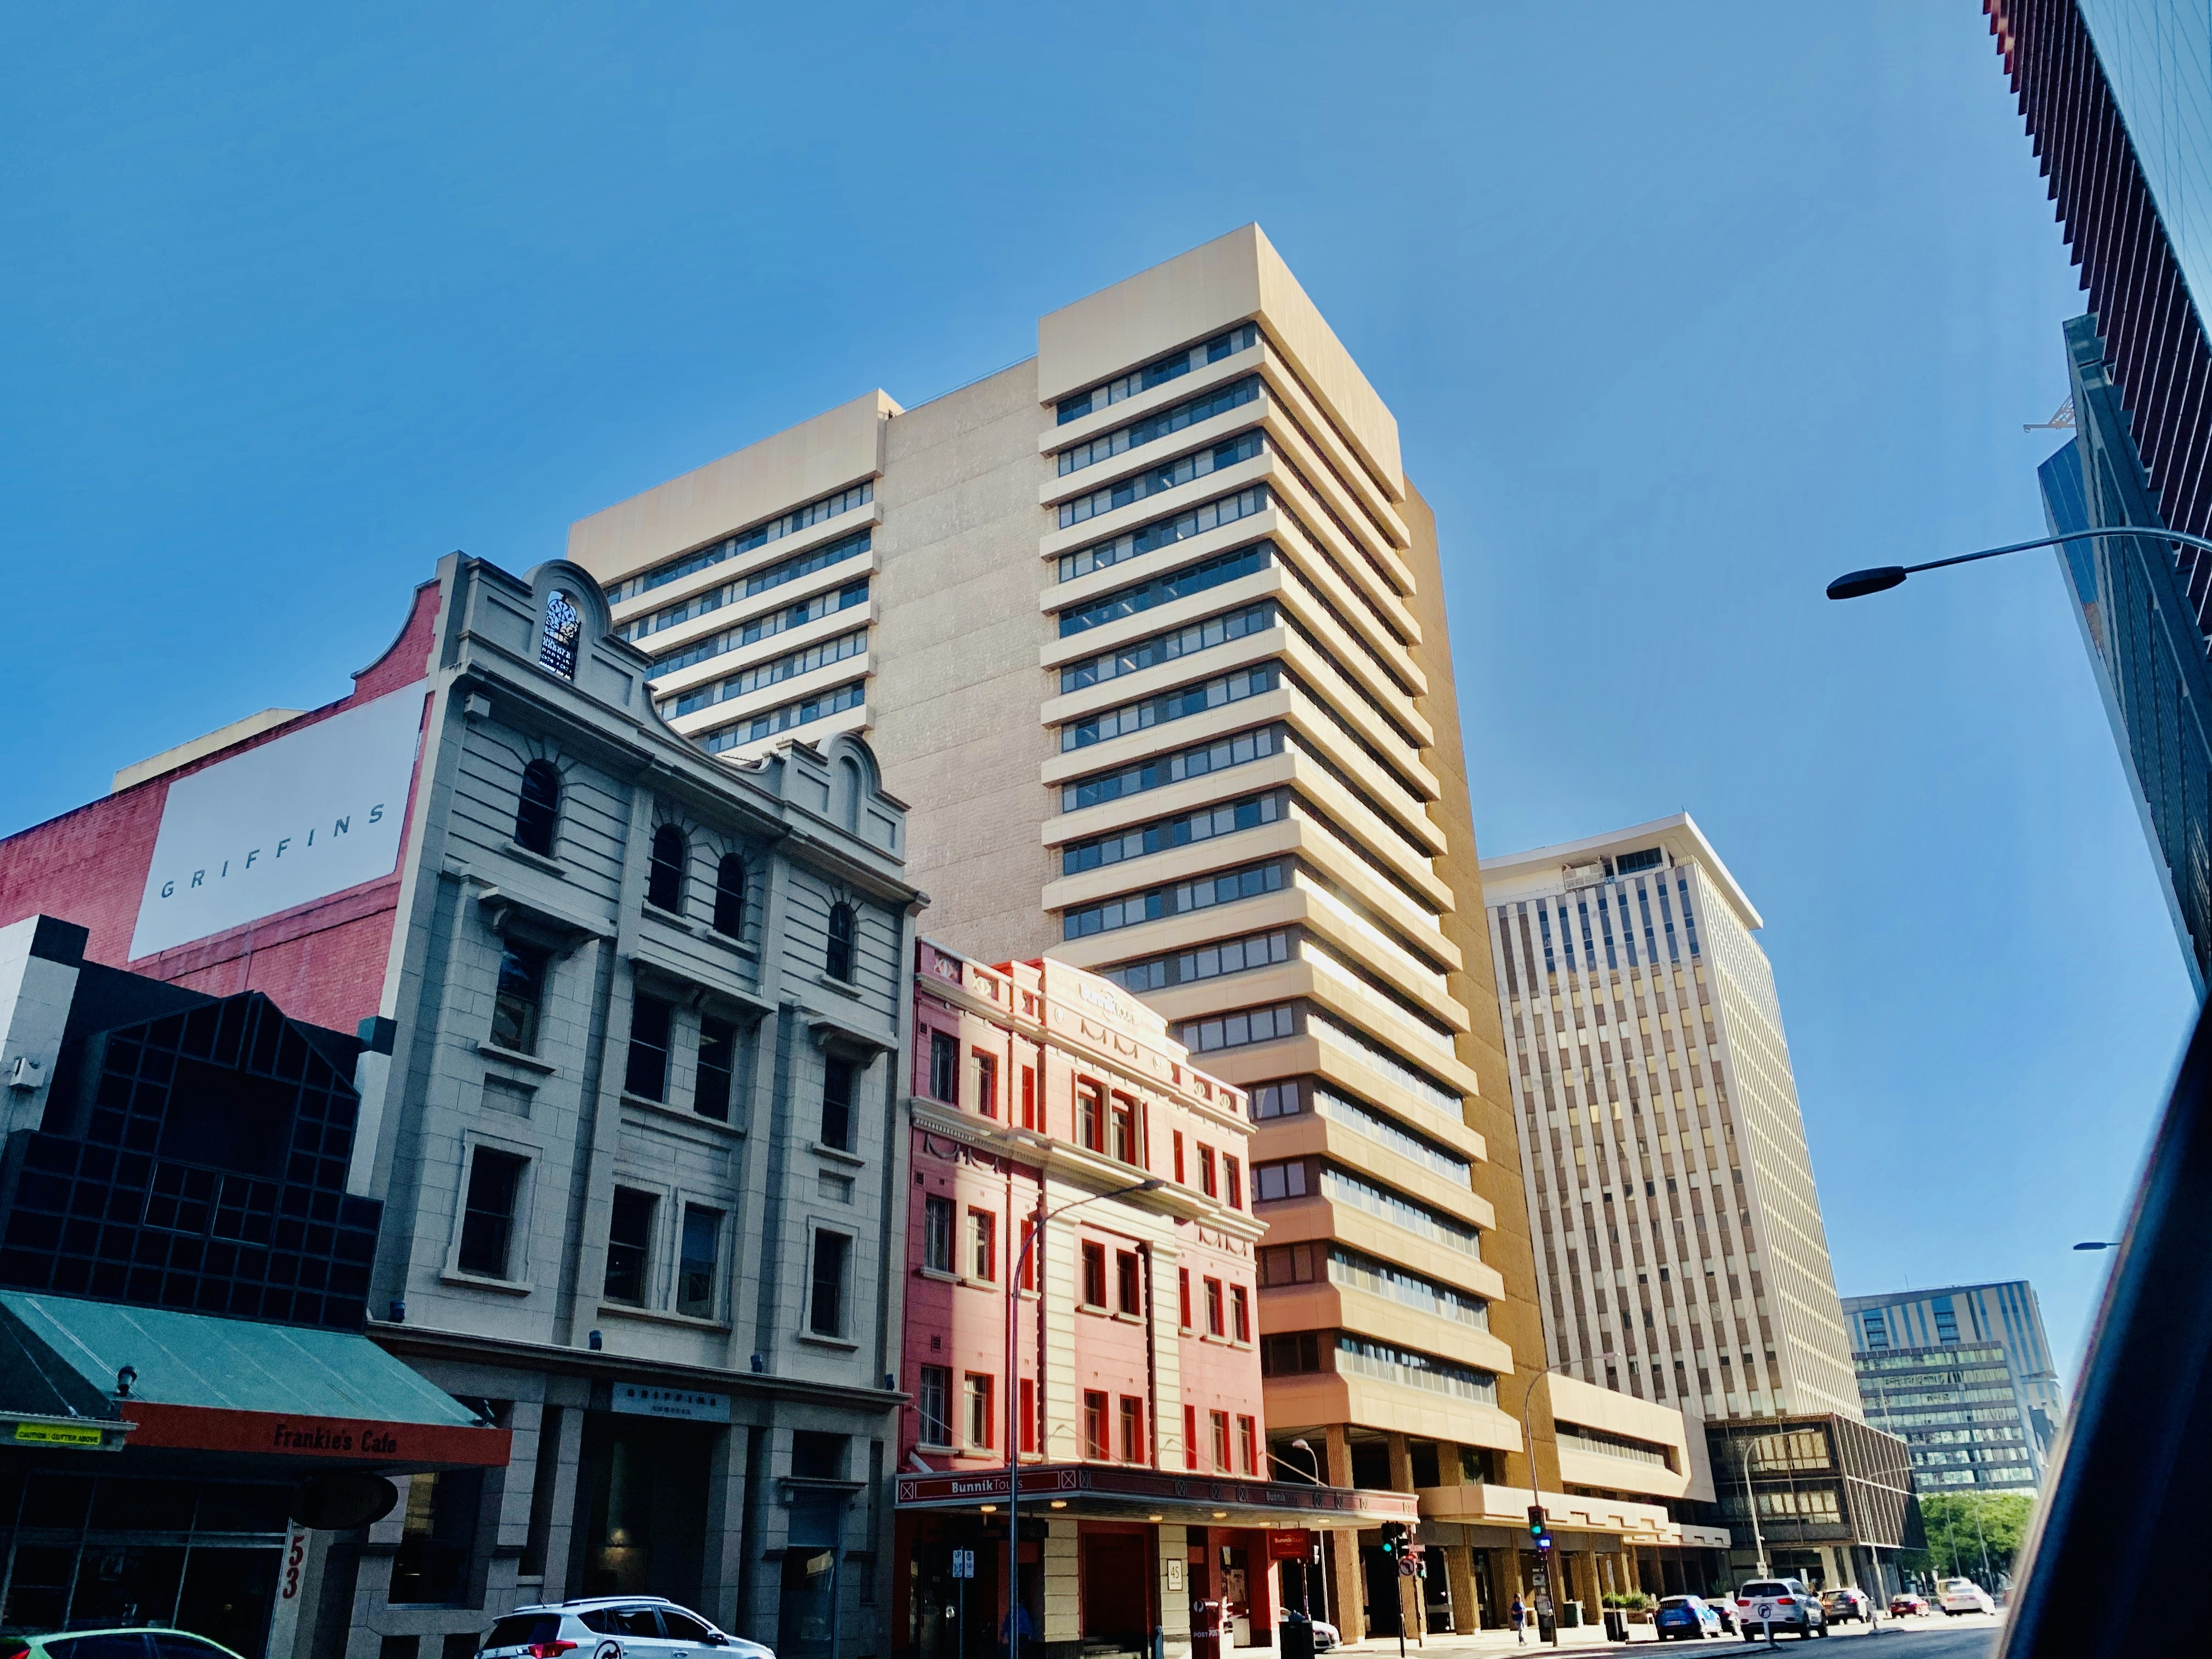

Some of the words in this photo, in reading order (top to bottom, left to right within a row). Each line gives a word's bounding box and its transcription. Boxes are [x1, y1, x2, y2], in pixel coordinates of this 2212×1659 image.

[161, 804, 383, 898] GRIFFINS
[273, 1424, 353, 1450] Frankie's
[360, 1430, 397, 1453] Cafe
[283, 1536, 304, 1599] 53
[1171, 1566, 1179, 1578] 45
